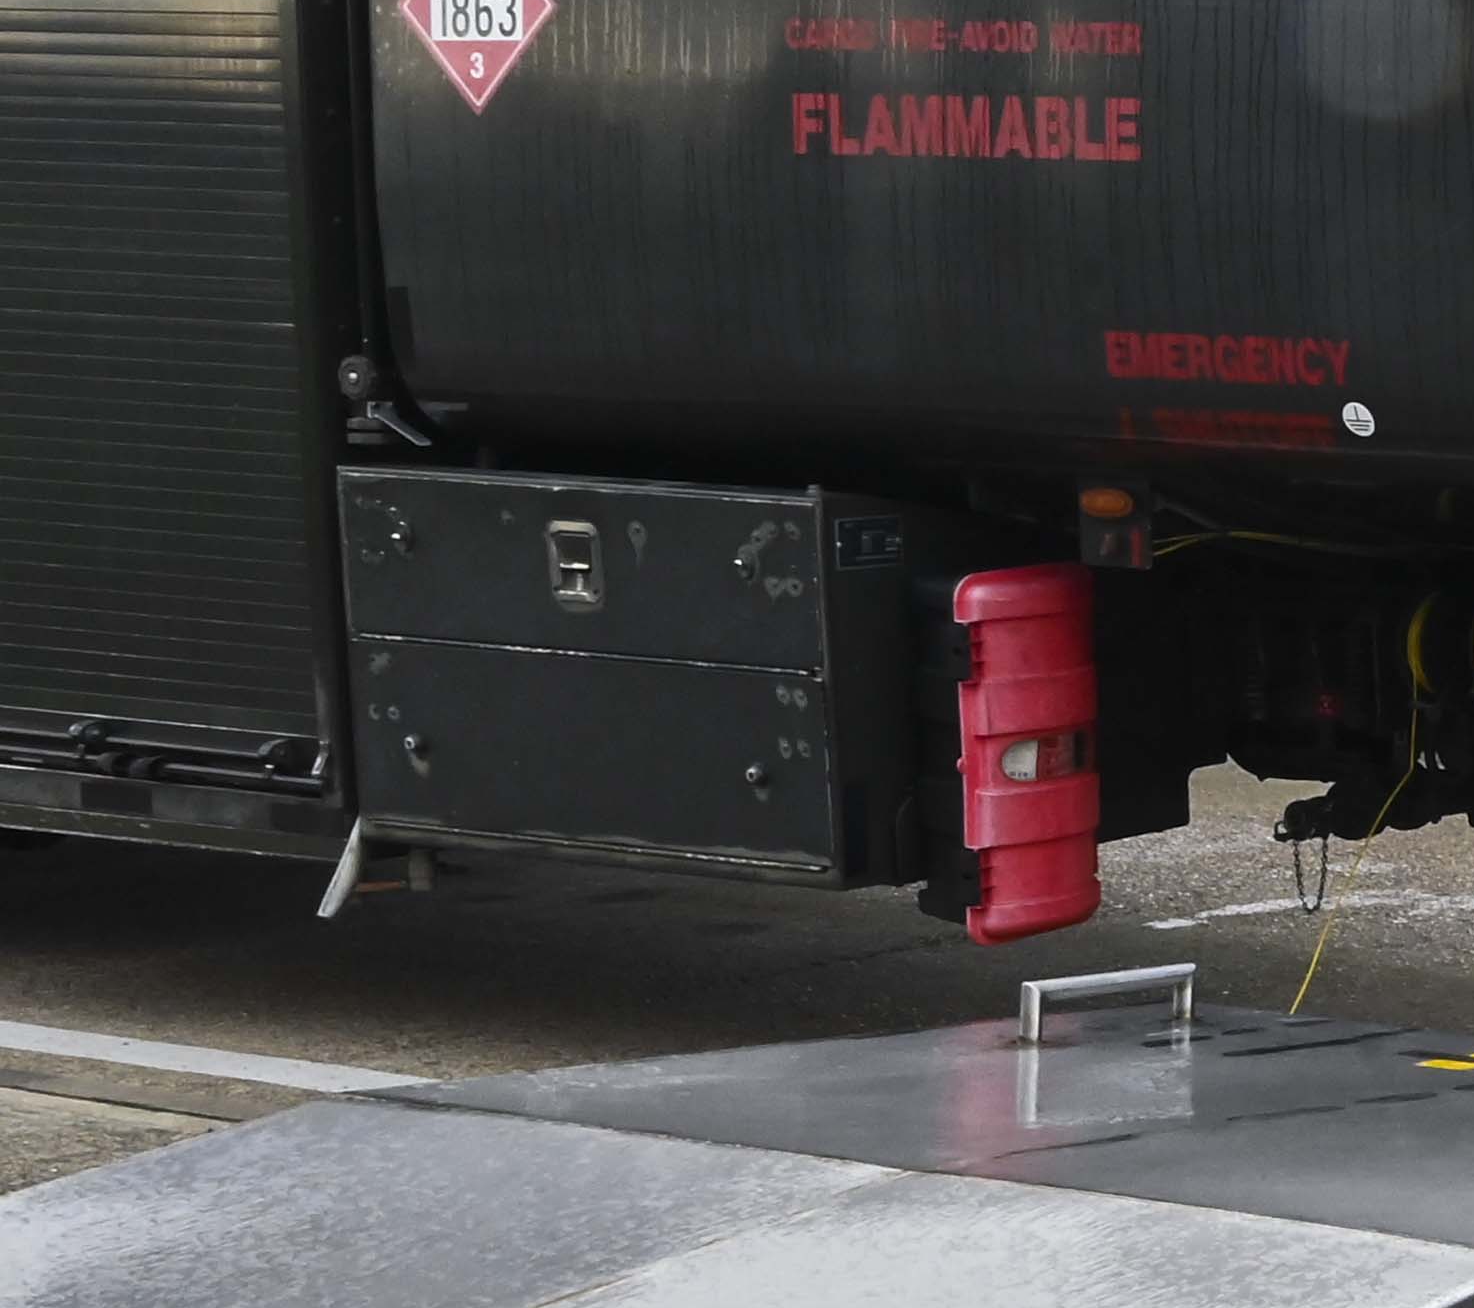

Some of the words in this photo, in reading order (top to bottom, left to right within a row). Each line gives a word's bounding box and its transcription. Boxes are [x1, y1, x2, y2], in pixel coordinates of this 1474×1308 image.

[1050, 21, 1142, 54] WATER
[469, 51, 485, 79] 3
[792, 92, 1141, 161] FLAMMABLE
[1104, 330, 1350, 386] EMERGENCY
